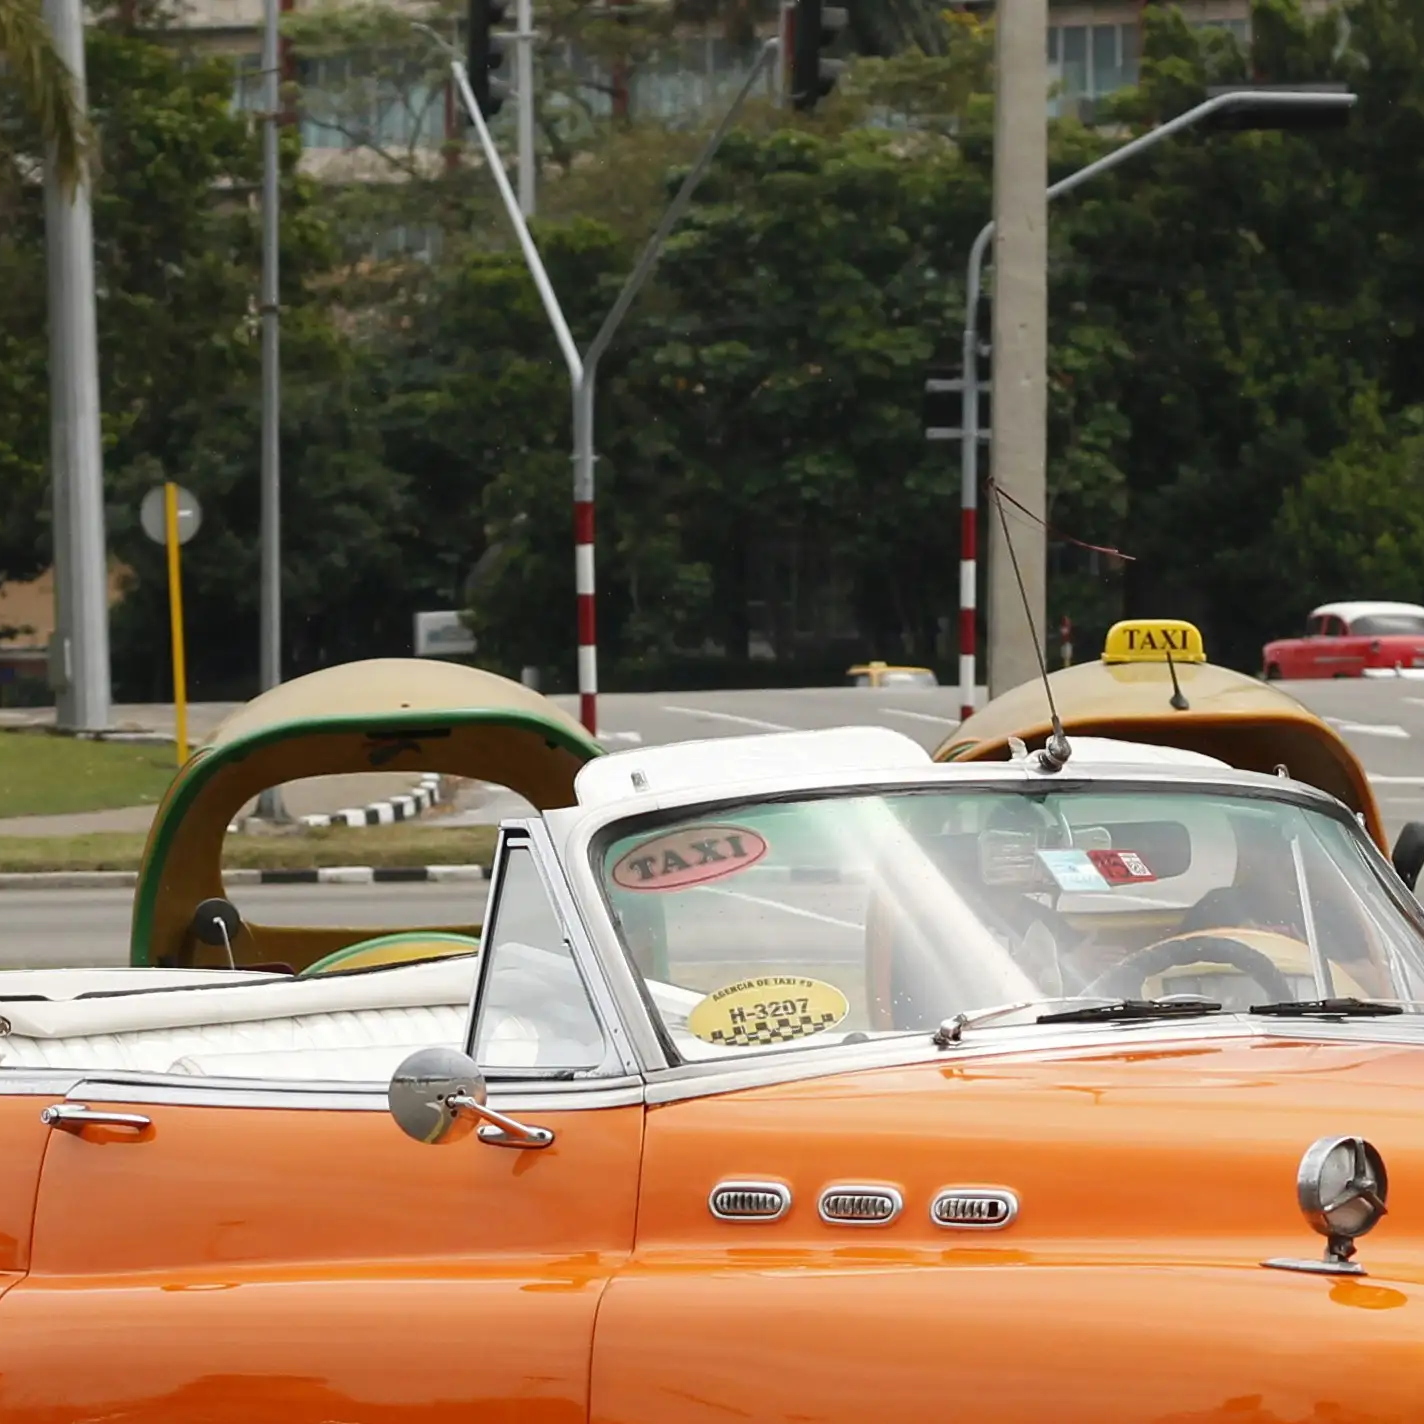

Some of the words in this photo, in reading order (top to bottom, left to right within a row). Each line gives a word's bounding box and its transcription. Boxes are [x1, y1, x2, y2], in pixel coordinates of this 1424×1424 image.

[1123, 628, 1192, 650] TAXI
[629, 835, 748, 882] TAXI
[712, 979, 755, 1002] AGENCIA
[756, 979, 769, 987] DE
[772, 977, 796, 986] TAXI
[729, 998, 809, 1025] H-3207
